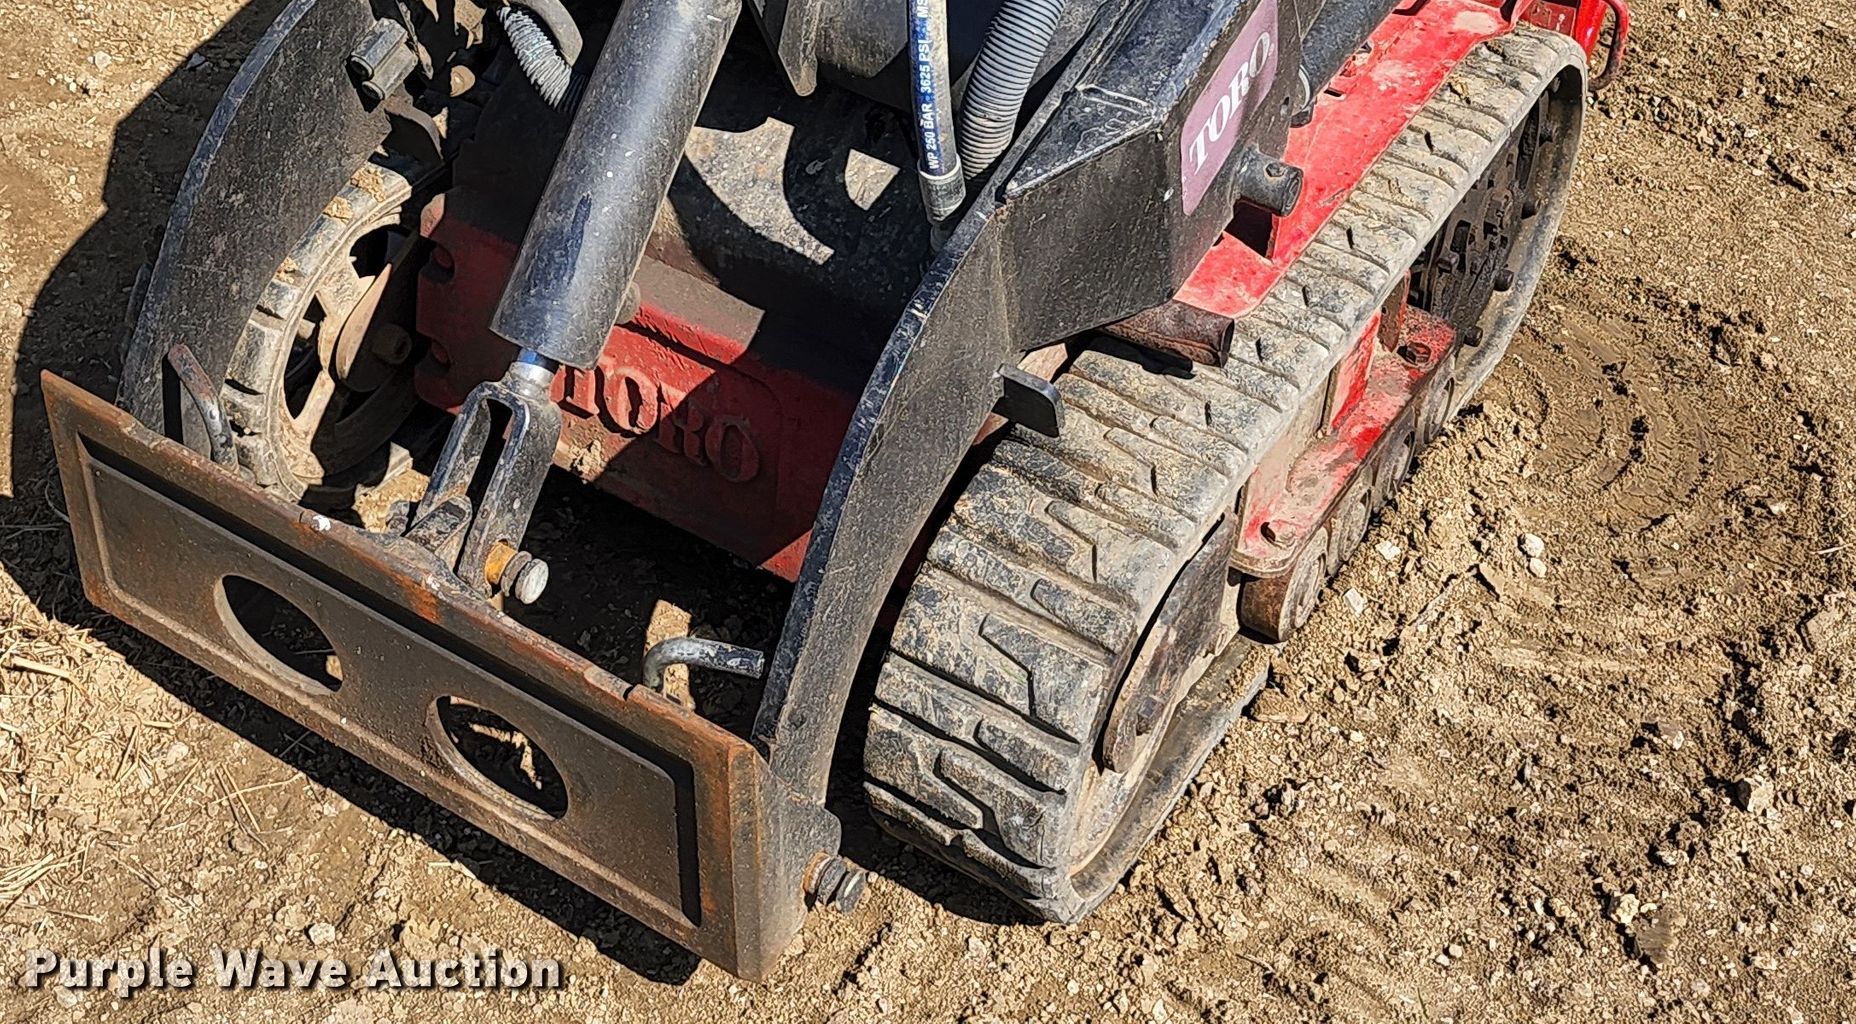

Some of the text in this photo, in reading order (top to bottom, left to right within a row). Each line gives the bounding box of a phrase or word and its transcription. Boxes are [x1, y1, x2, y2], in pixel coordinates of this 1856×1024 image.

[919, 64, 932, 94] 3625
[920, 102, 935, 129] BAR
[1189, 32, 1272, 175] TORO
[925, 131, 938, 152] 250
[926, 153, 940, 170] WP
